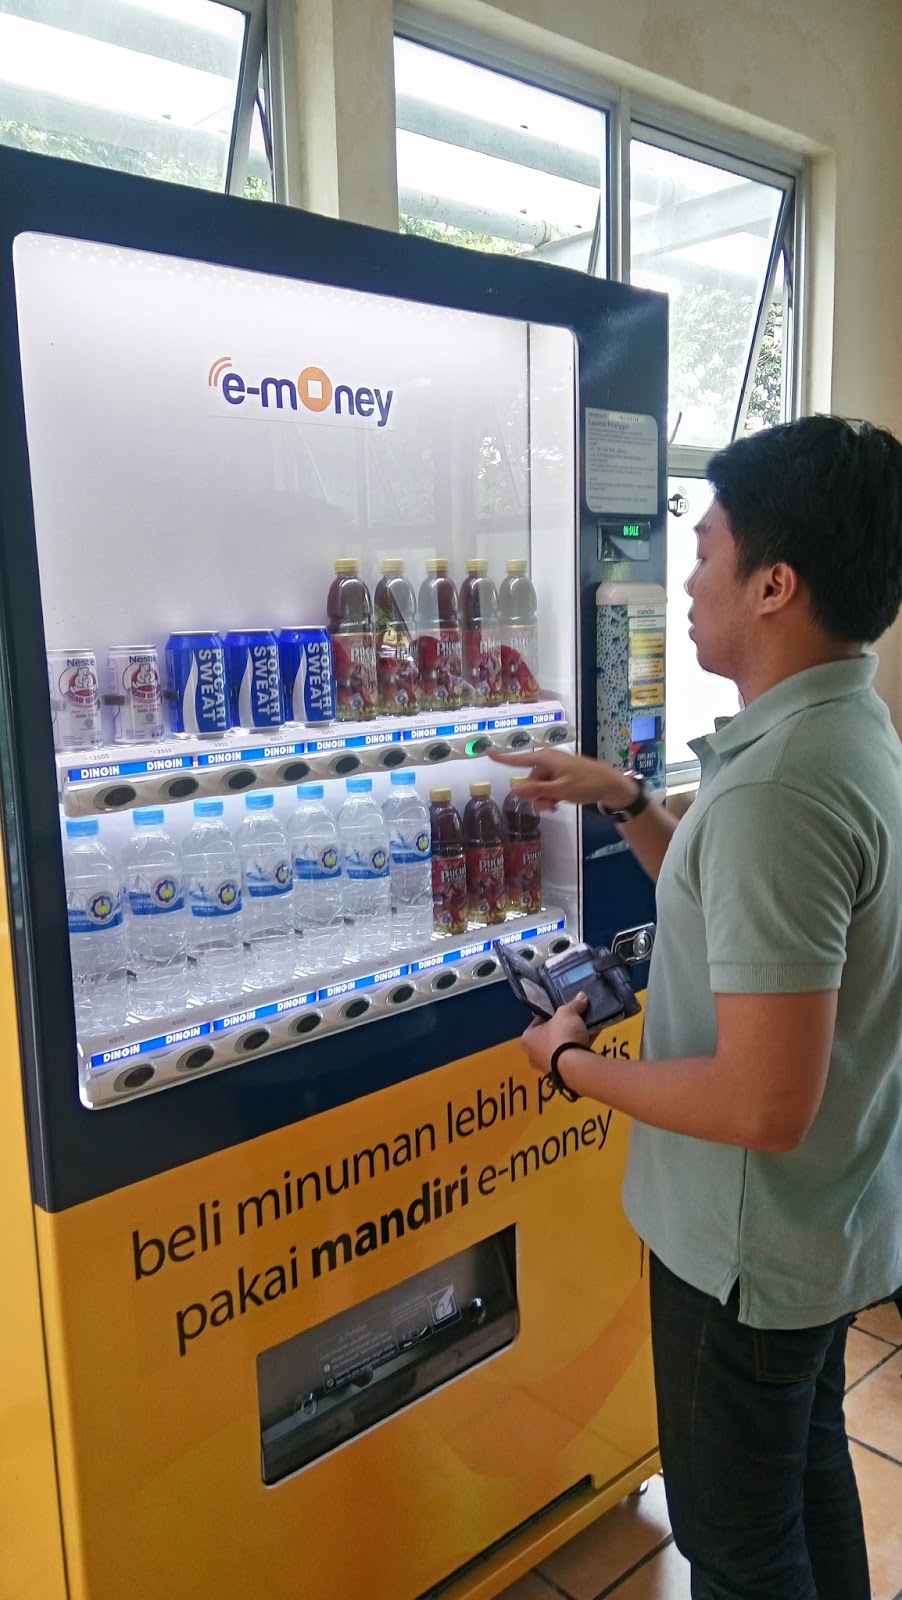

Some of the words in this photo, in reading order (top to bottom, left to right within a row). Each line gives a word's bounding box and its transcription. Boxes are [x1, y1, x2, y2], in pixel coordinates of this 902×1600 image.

[254, 646, 271, 715] SWEAT
[266, 644, 280, 722] POCARI
[308, 642, 323, 710] SWEAT
[320, 641, 332, 717] POCARI
[199, 649, 216, 721] SWEAT
[212, 648, 226, 728] POCARI
[494, 718, 518, 728] DINGIN
[532, 714, 555, 723] DINGIN
[411, 728, 437, 738] DINGIN
[454, 723, 478, 733] DINGIN
[317, 739, 345, 750] DINGIN
[365, 733, 393, 744] DINGIN
[208, 752, 242, 764] DINGIN
[264, 745, 295, 757] DINGIN
[81, 765, 120, 779] DINGIN
[146, 758, 183, 771] DINGIN
[536, 923, 558, 935] DINGIN
[460, 944, 484, 958] DINGIN
[418, 956, 444, 970] DINGIN
[374, 968, 401, 983] DINGIN
[327, 981, 356, 997] DINGIN
[277, 995, 307, 1012] DINGIN
[223, 1011, 256, 1027] DINGIN
[165, 1027, 200, 1045] DINGIN
[103, 1044, 140, 1063] DINGIN
[132, 1200, 222, 1281] beli
[237, 1123, 436, 1236] minuman
[447, 1076, 527, 1144] lebih
[538, 1037, 631, 1115] ptis
[175, 1246, 299, 1356] pakai
[311, 1165, 469, 1279] mandiri
[478, 1109, 613, 1196] e-money
